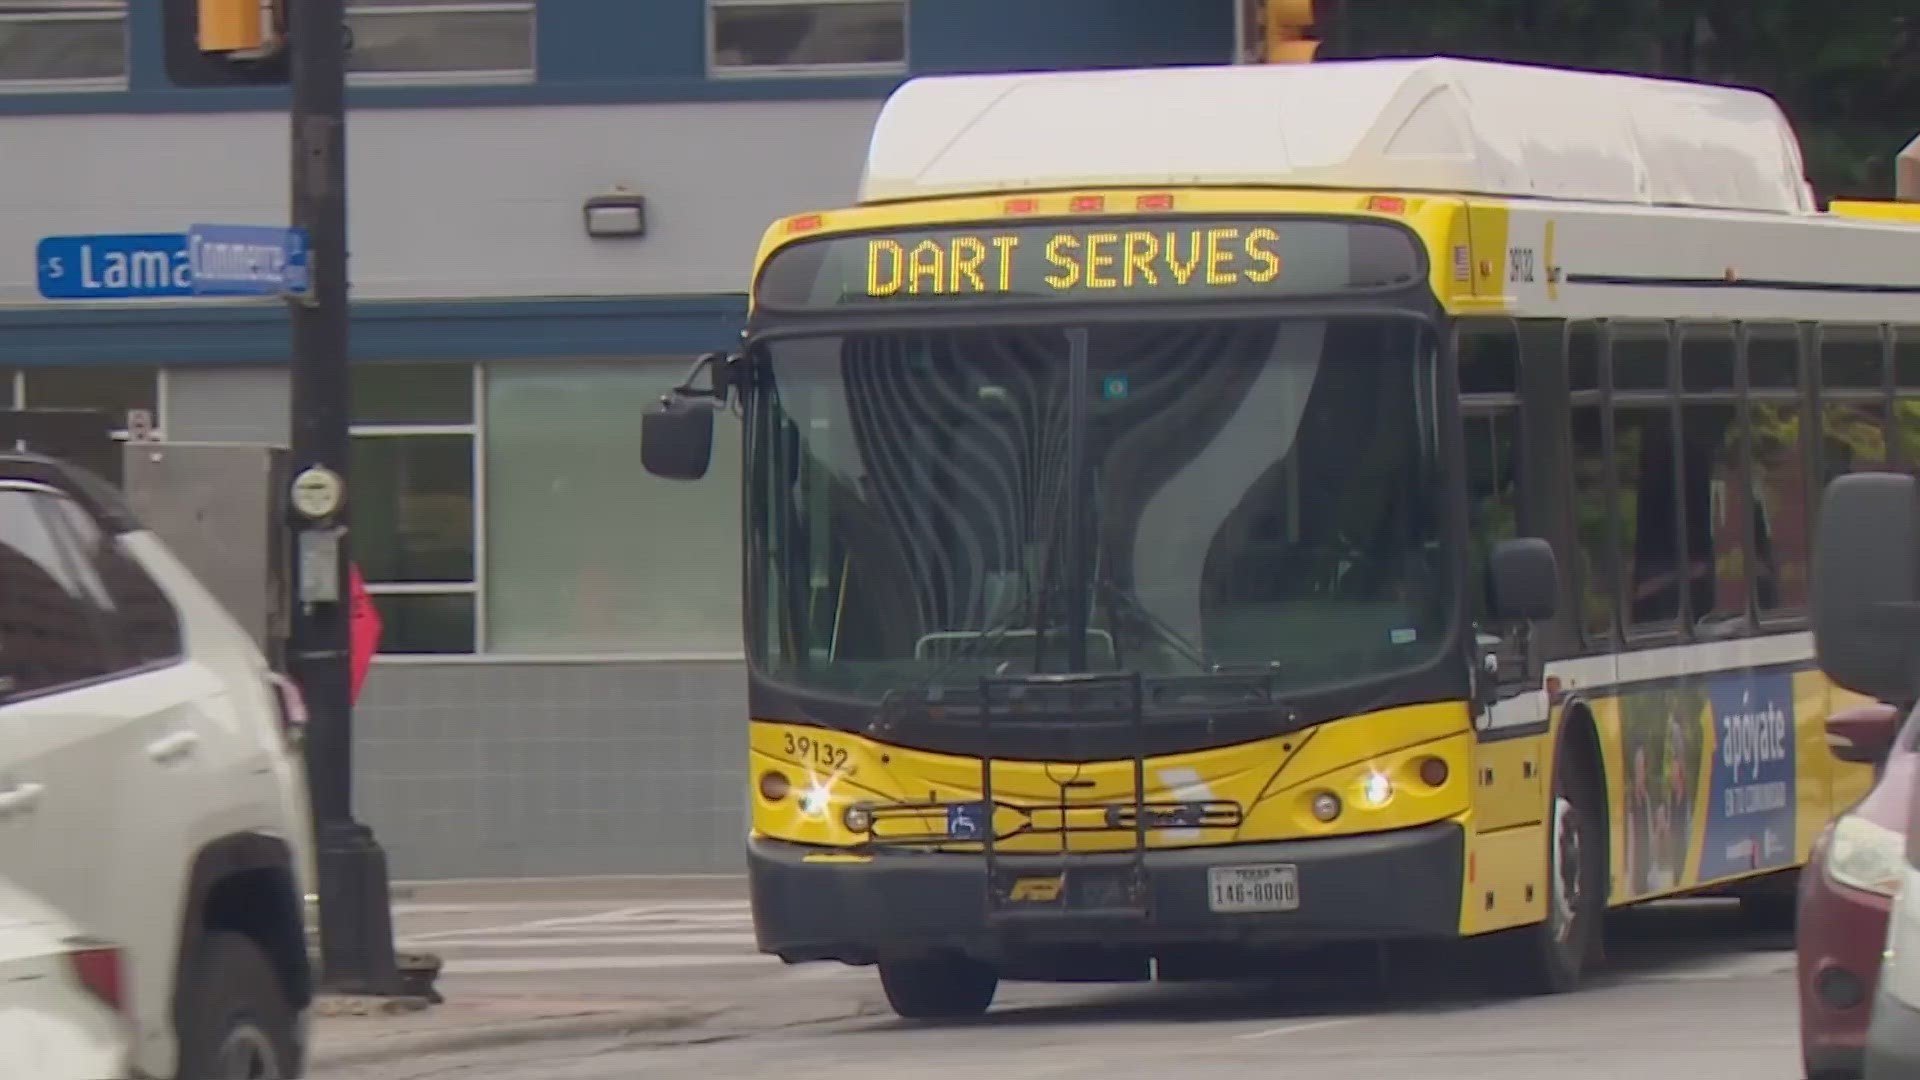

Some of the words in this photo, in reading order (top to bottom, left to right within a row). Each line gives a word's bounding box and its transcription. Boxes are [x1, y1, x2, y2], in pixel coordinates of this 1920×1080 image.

[48, 255, 64, 279] S
[79, 244, 192, 289] Lama
[866, 236, 1019, 296] DART
[1043, 228, 1280, 289] SERVES
[783, 731, 849, 771] 39132
